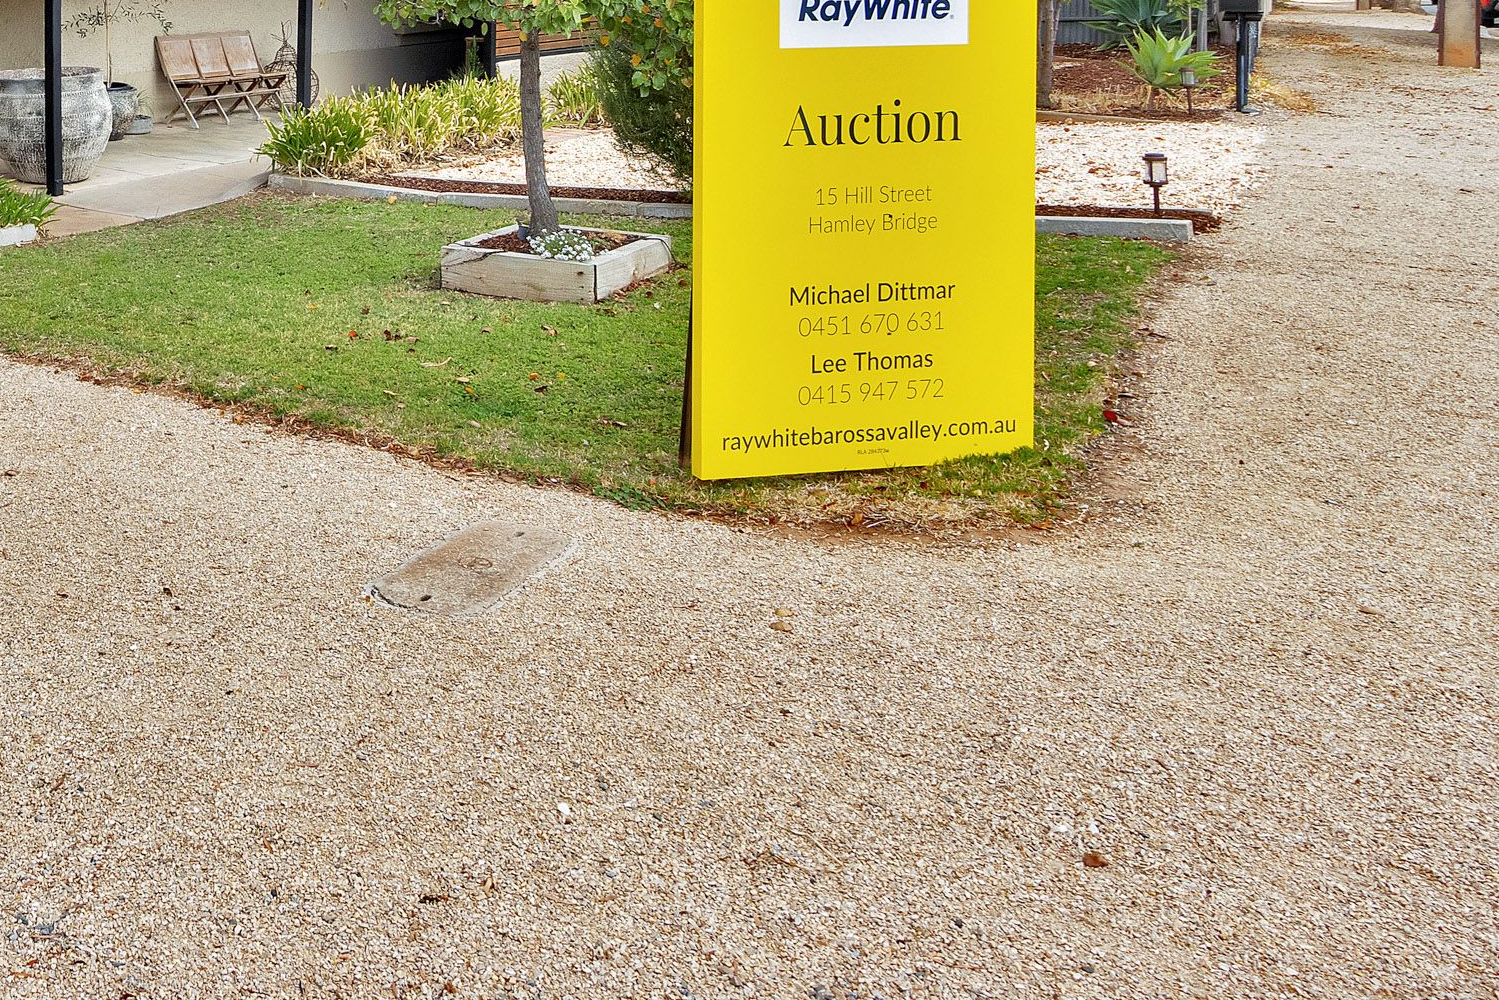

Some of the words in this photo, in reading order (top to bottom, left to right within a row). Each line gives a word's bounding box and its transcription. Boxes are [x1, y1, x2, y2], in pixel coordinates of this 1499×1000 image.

[783, 99, 962, 146] Auction
[815, 187, 838, 206] 15
[845, 185, 873, 204] Hill
[879, 184, 933, 204] Street
[809, 212, 876, 236] Hamley
[882, 212, 938, 234] Bridge
[790, 283, 870, 306] Michael
[878, 281, 956, 302] Dittmar
[798, 315, 852, 338] 0451
[859, 313, 900, 336] 670
[906, 311, 945, 332] 631
[811, 354, 847, 374] Lee
[853, 350, 934, 371] Thomas
[798, 383, 851, 406] 0415
[859, 380, 899, 403] 947
[906, 378, 945, 400] 572
[722, 418, 1017, 454] raywhitebarossavalley.com.au
